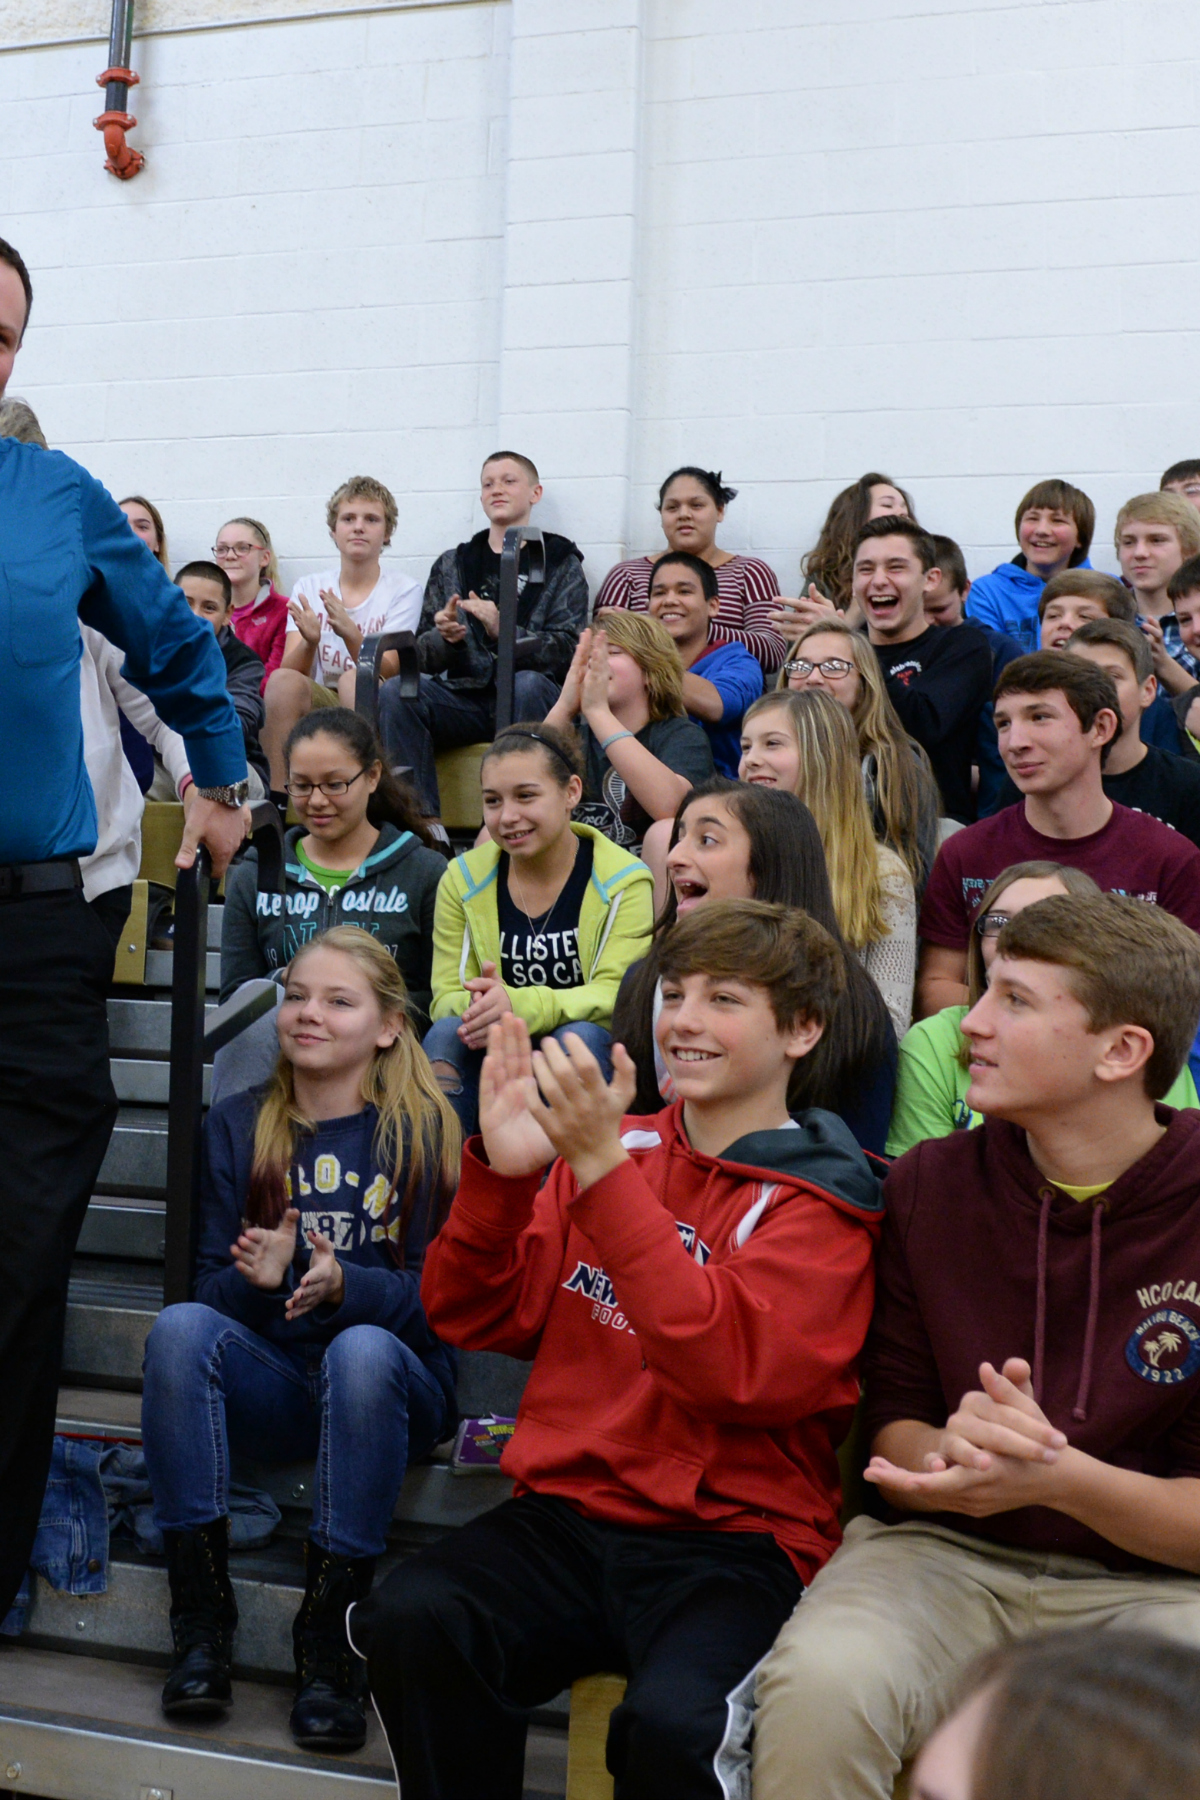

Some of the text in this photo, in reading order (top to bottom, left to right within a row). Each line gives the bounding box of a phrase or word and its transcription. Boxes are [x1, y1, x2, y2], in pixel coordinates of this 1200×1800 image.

[512, 962, 547, 986] SO
[1168, 1311, 1200, 1341] BEACH
[1141, 1365, 1185, 1384] 1922
